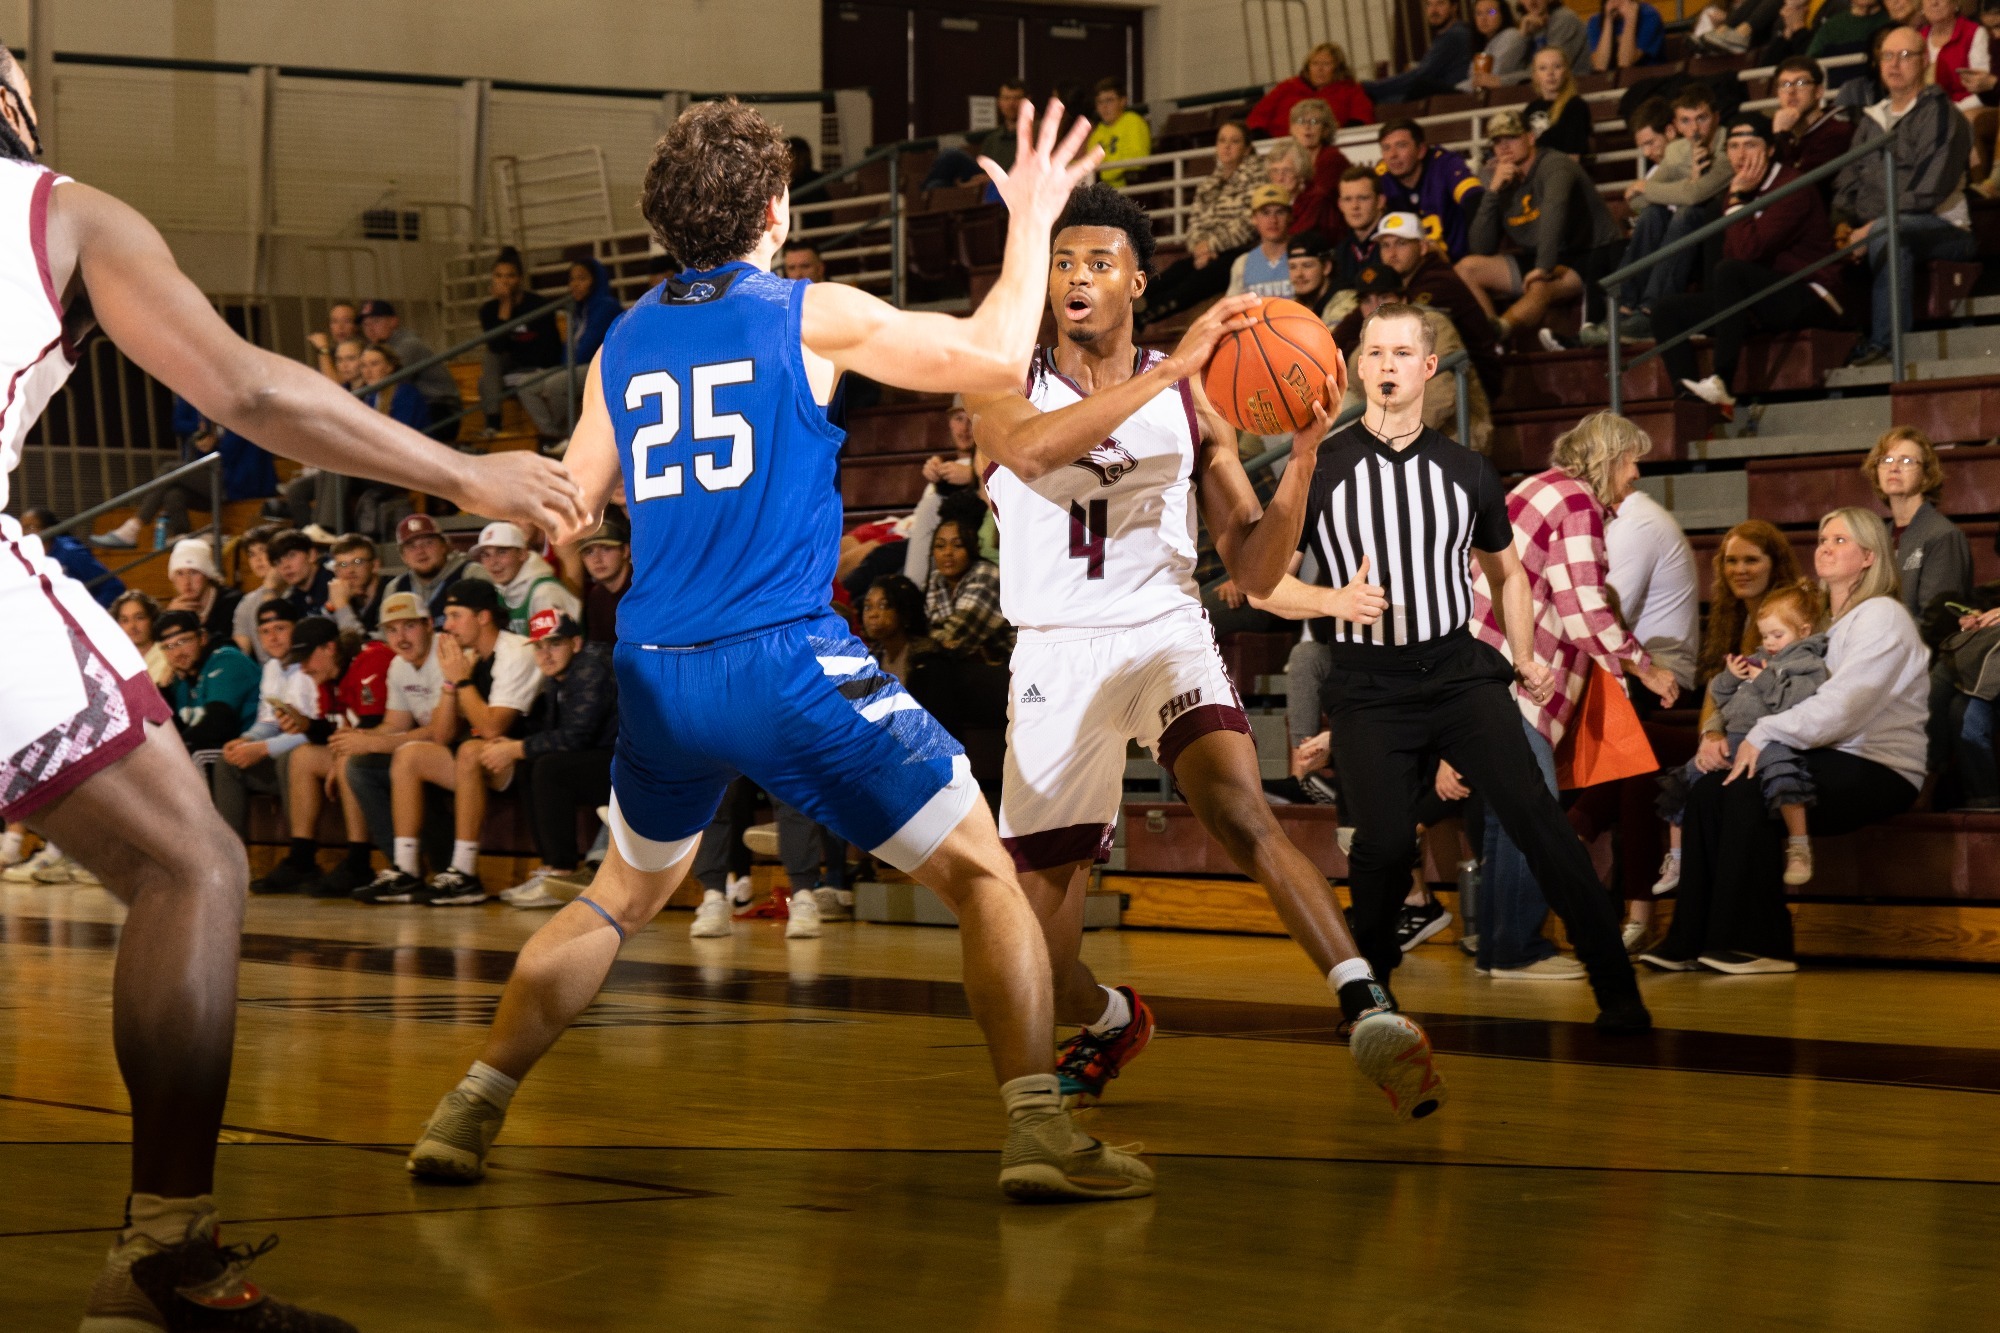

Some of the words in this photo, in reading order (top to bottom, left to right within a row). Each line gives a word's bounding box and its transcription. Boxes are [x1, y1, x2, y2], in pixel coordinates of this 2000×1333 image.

[1281, 361, 1315, 411] SPAL
[624, 358, 755, 504] 25
[1069, 499, 1108, 580] 4
[529, 615, 554, 632] USA
[1158, 687, 1203, 730] FHU
